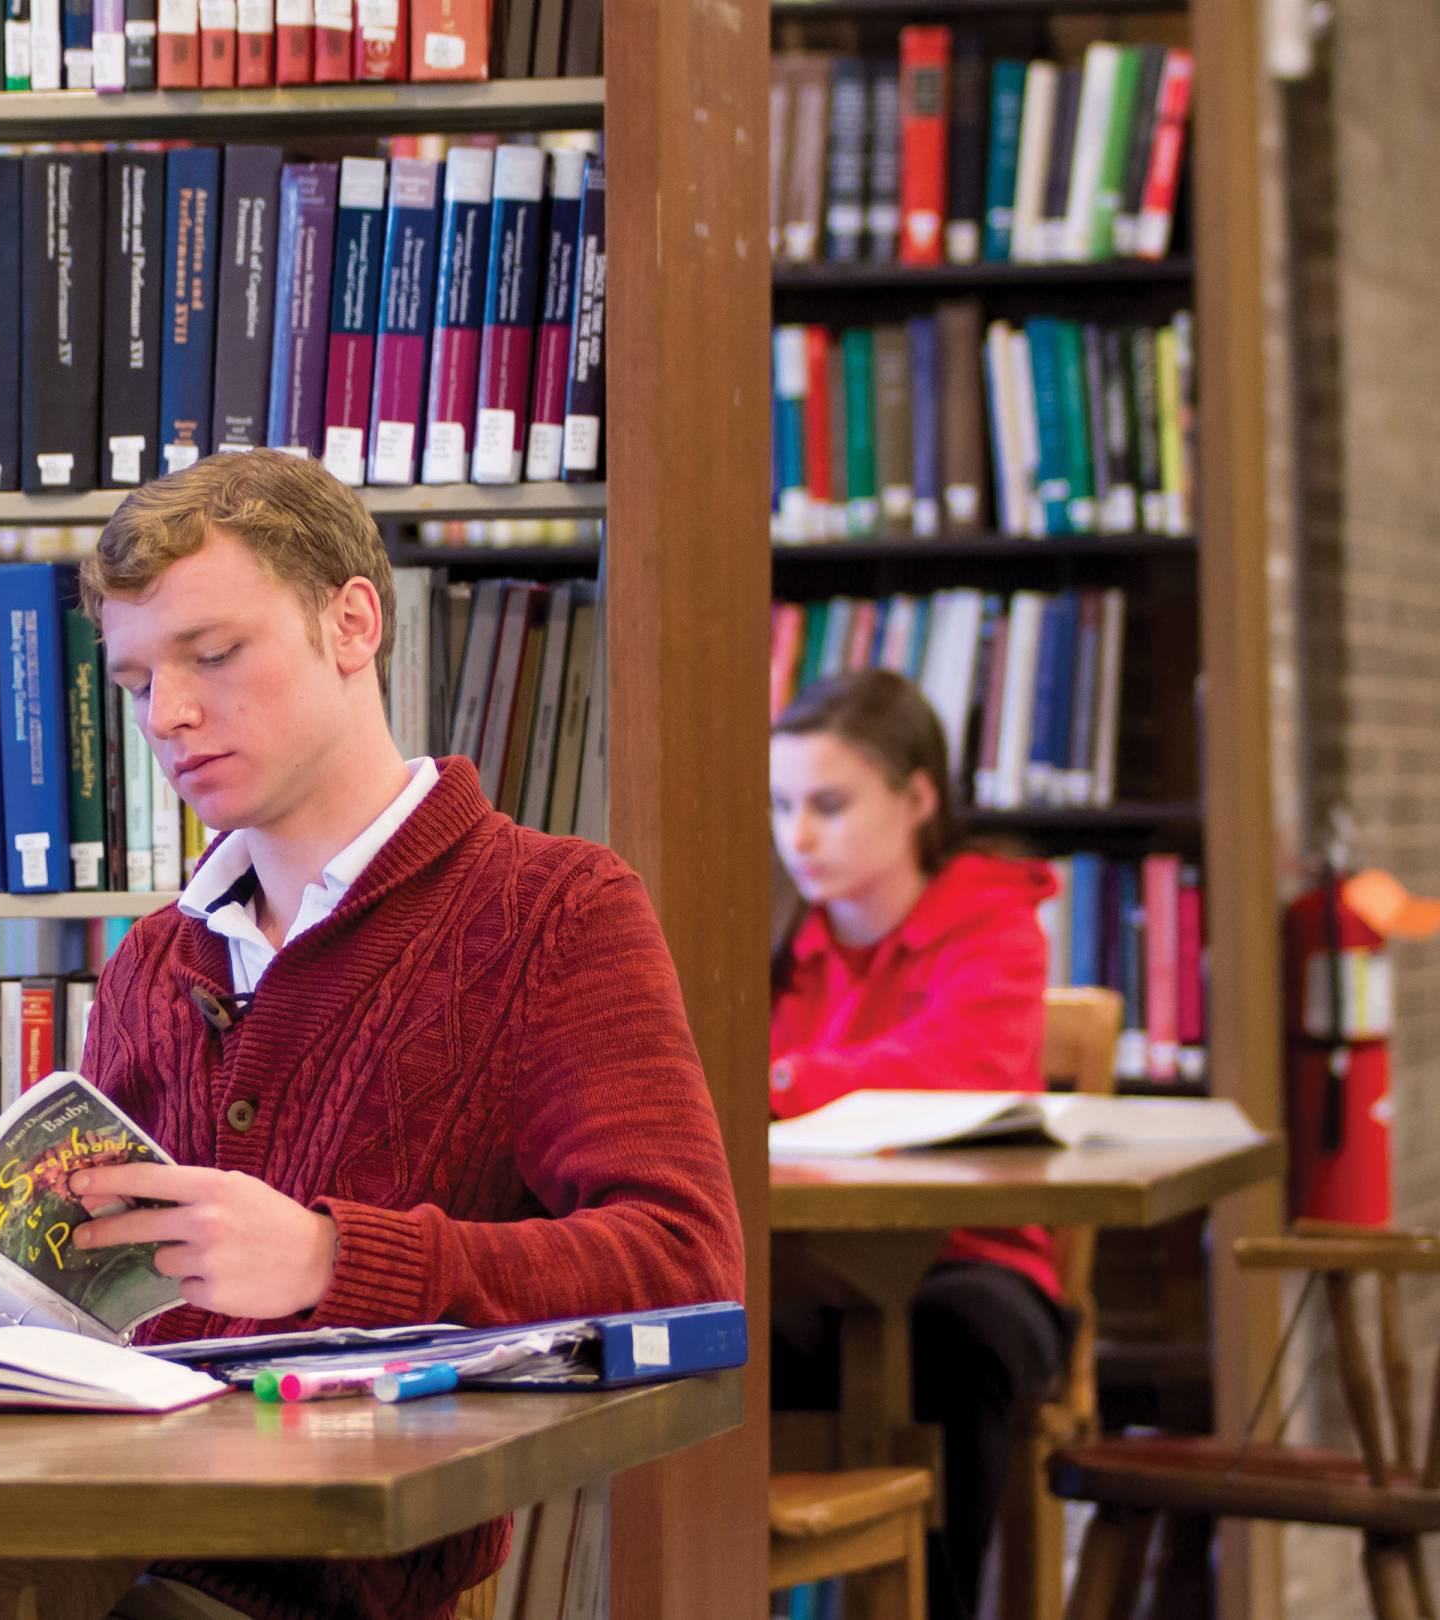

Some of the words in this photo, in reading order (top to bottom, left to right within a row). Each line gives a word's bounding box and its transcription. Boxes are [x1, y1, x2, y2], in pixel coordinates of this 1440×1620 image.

[58, 165, 72, 223] Attention
[132, 167, 145, 225] Attention
[58, 228, 72, 252] and
[132, 230, 145, 253] and
[176, 188, 192, 297] Performance
[193, 189, 207, 272] Attention
[235, 198, 249, 265] Processes
[250, 198, 265, 250] Control
[249, 253, 263, 271] of
[402, 267, 413, 283] and
[582, 235, 597, 293] NUMBER
[58, 256, 72, 340] Performance
[131, 256, 145, 337] Performance
[192, 278, 204, 310] and
[245, 273, 262, 338] Cognitive
[581, 295, 594, 311] IN
[579, 312, 592, 336] THE
[576, 339, 591, 382] BRAIN
[76, 662, 93, 699] Sight
[79, 701, 94, 727] and
[79, 728, 96, 798] Sensibility
[5, 1091, 77, 1150] Jean-Dominique
[40, 1101, 90, 1134] Bauby
